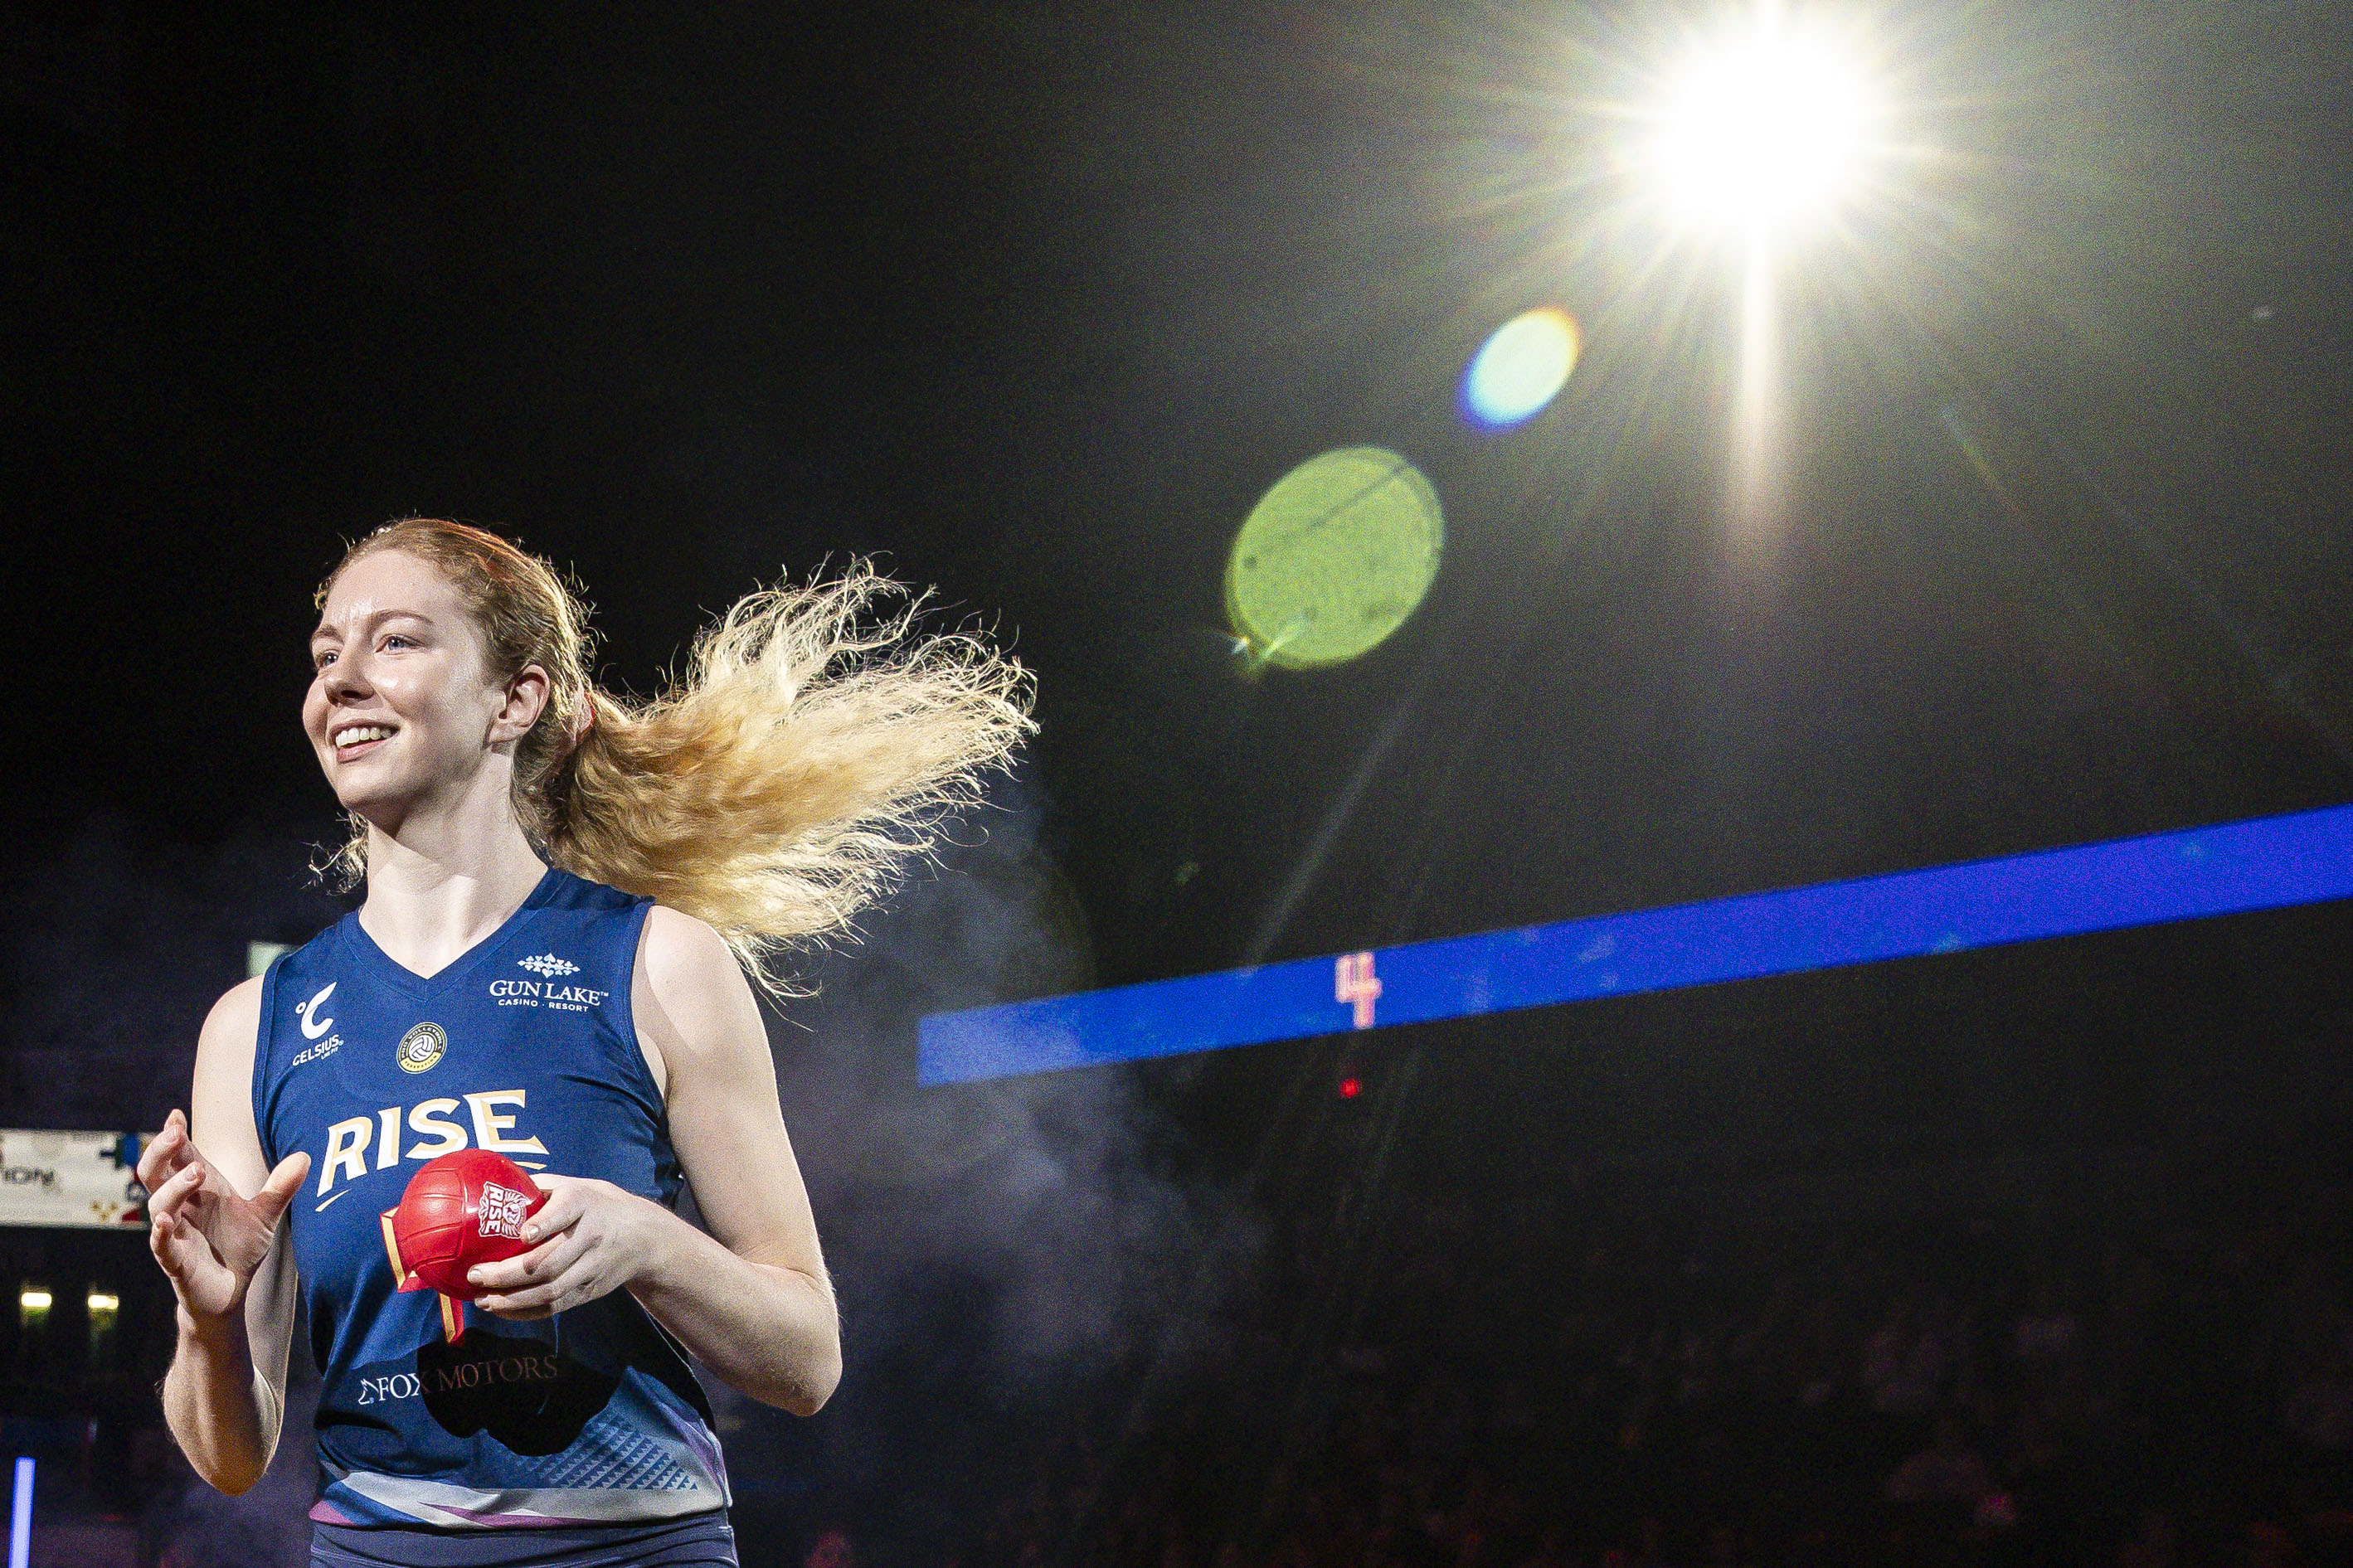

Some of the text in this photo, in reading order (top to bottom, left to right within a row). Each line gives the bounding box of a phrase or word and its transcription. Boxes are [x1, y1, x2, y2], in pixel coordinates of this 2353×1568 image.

[489, 980, 542, 998] GUN
[498, 998, 589, 1012] CASINO RESORT
[1335, 951, 1382, 1029] 4
[316, 1089, 549, 1198] RISE
[484, 1185, 505, 1235] RISE
[377, 1355, 557, 1401] FOX MOTORS
